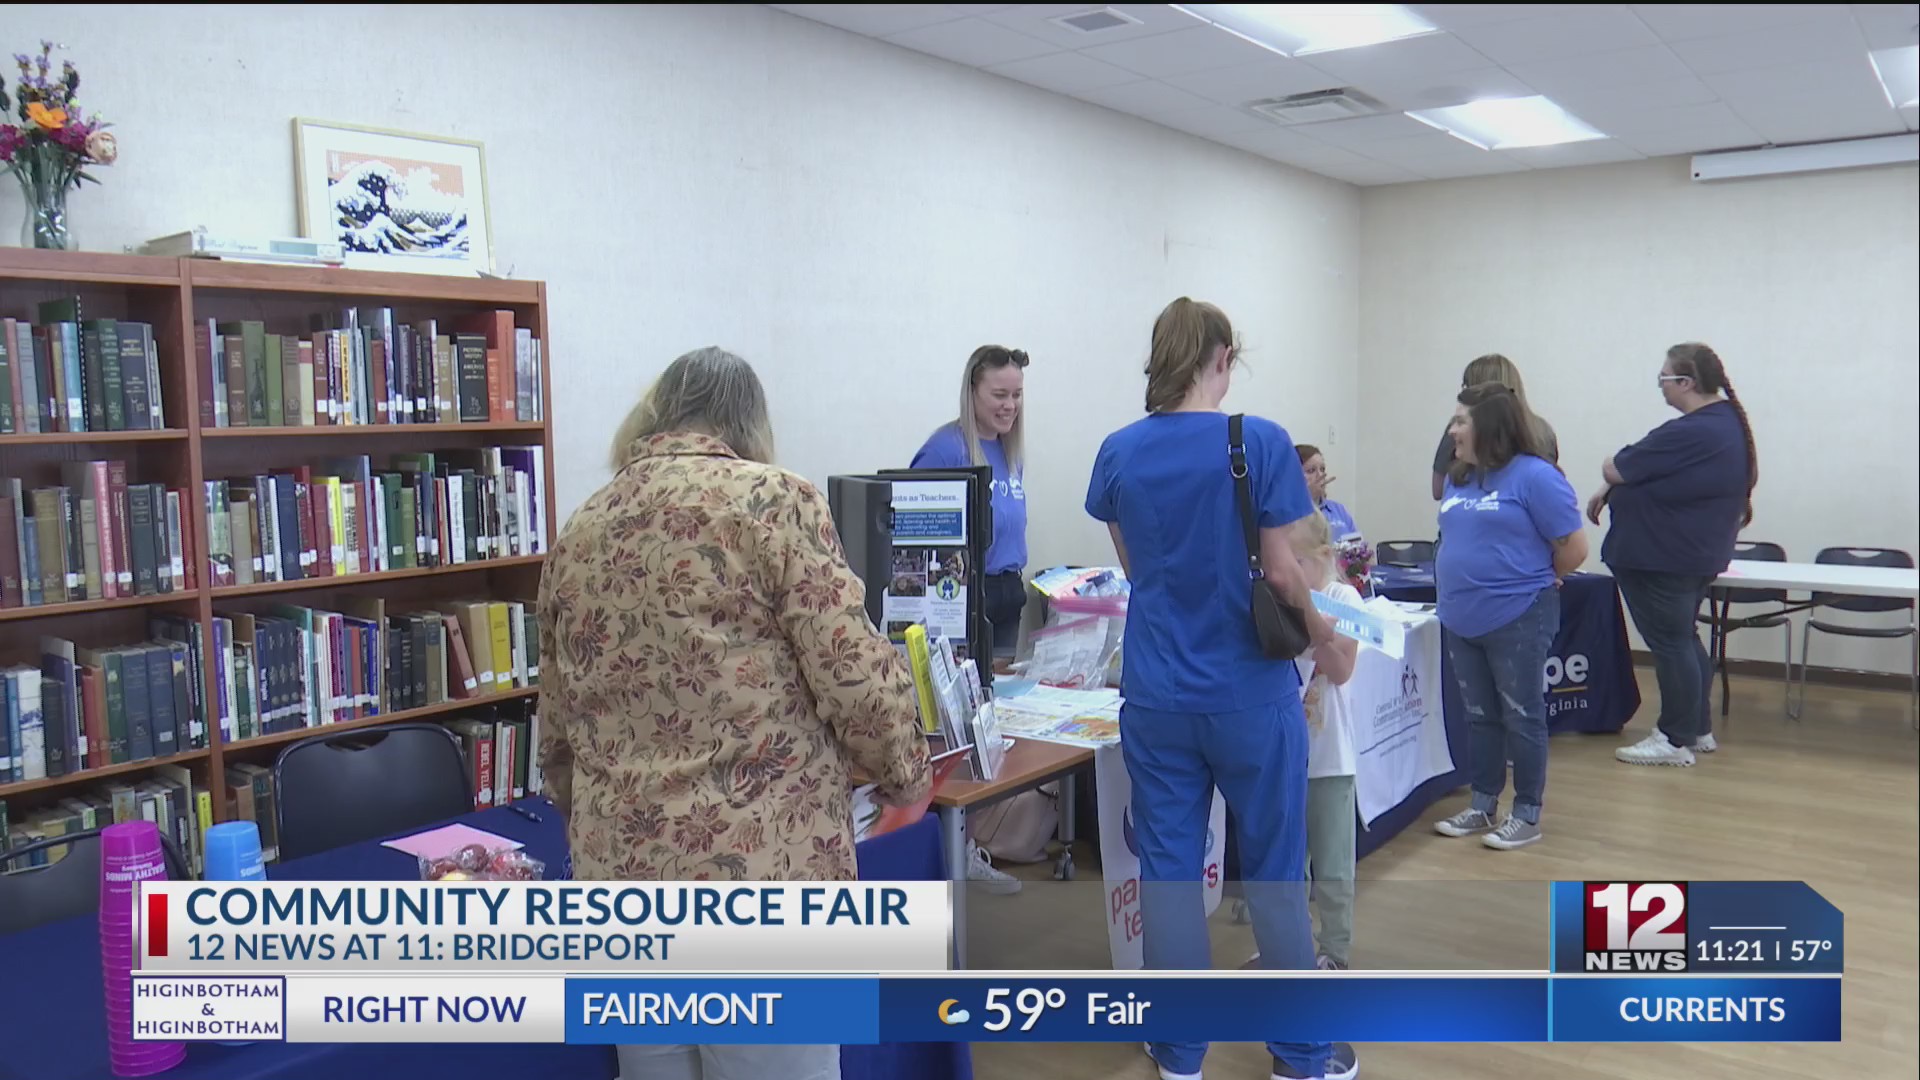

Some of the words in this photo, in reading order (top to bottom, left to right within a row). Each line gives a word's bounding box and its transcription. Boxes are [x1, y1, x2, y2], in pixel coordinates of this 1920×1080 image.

[1543, 653, 1589, 693] pe
[1544, 697, 1588, 717] ginia
[480, 742, 490, 768] REBEL
